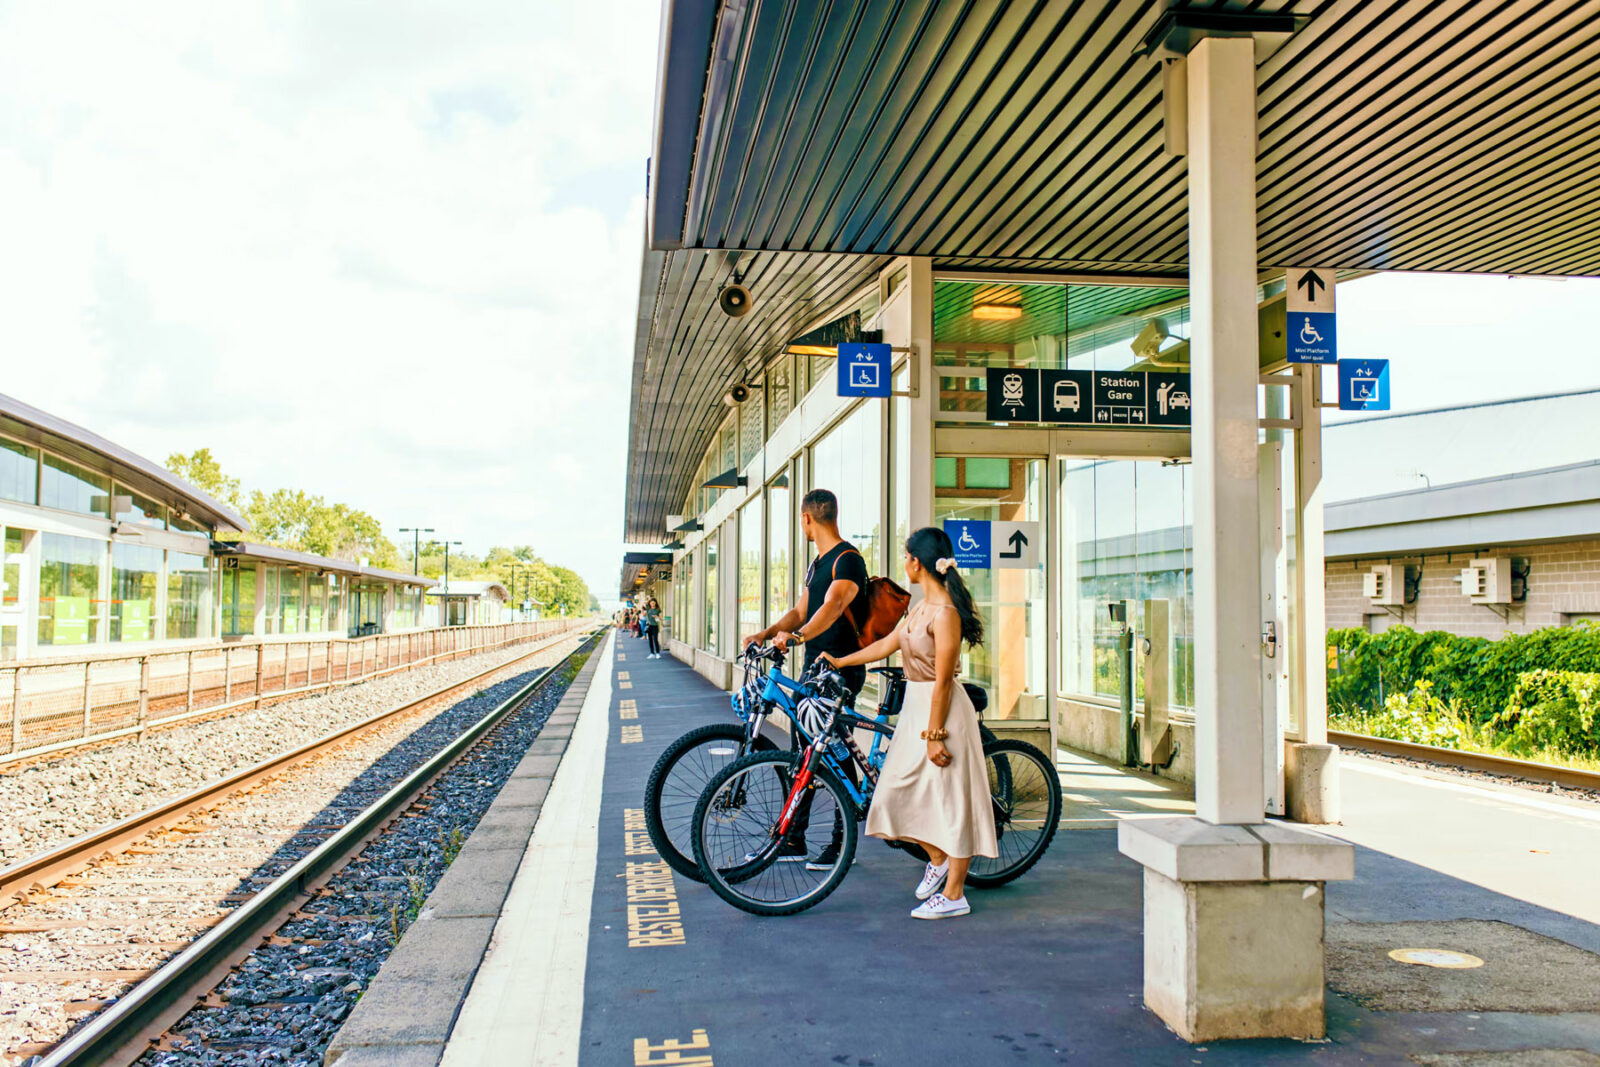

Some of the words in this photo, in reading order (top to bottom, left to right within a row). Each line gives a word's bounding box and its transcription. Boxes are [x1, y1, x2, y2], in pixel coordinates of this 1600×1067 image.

[1100, 377, 1140, 388] Station
[1107, 390, 1133, 400] Gare
[1010, 407, 1016, 418] 1
[628, 902, 686, 948] RESTEZ
